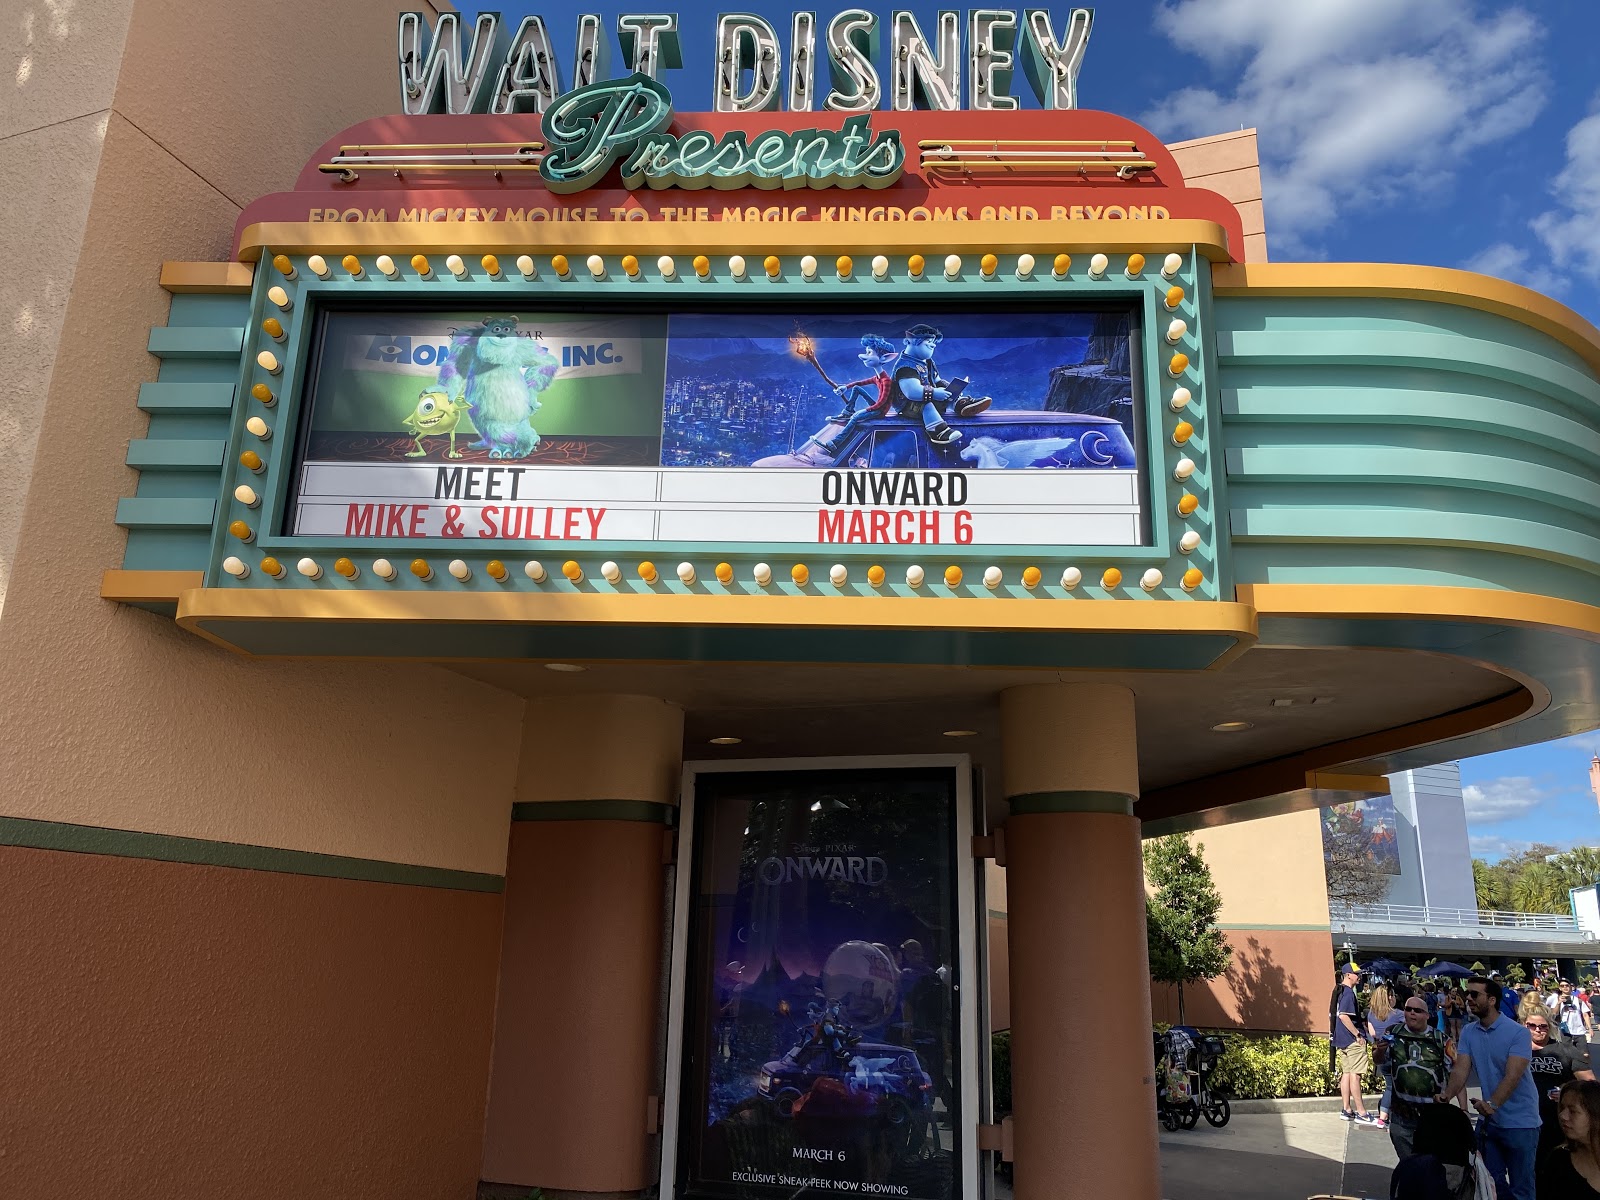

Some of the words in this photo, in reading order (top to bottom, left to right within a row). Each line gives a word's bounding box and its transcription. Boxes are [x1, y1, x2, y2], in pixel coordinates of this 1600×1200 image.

[715, 8, 1096, 111] DISNEY
[540, 73, 905, 193] Presents
[562, 342, 623, 367] INC.
[434, 466, 526, 501] MEET
[822, 470, 968, 506] ONWARD
[345, 503, 430, 538] MIKE
[440, 504, 465, 539] &
[478, 506, 608, 541] SULLEY
[818, 509, 940, 544] MARCH
[954, 511, 974, 545] 6
[759, 856, 889, 886] ONWARD
[792, 1147, 833, 1162] MARCH
[837, 1150, 846, 1161] 6
[732, 1171, 776, 1184] EXCLUSIVE
[833, 1180, 859, 1191] NOW
[861, 1182, 909, 1195] SHOWING
